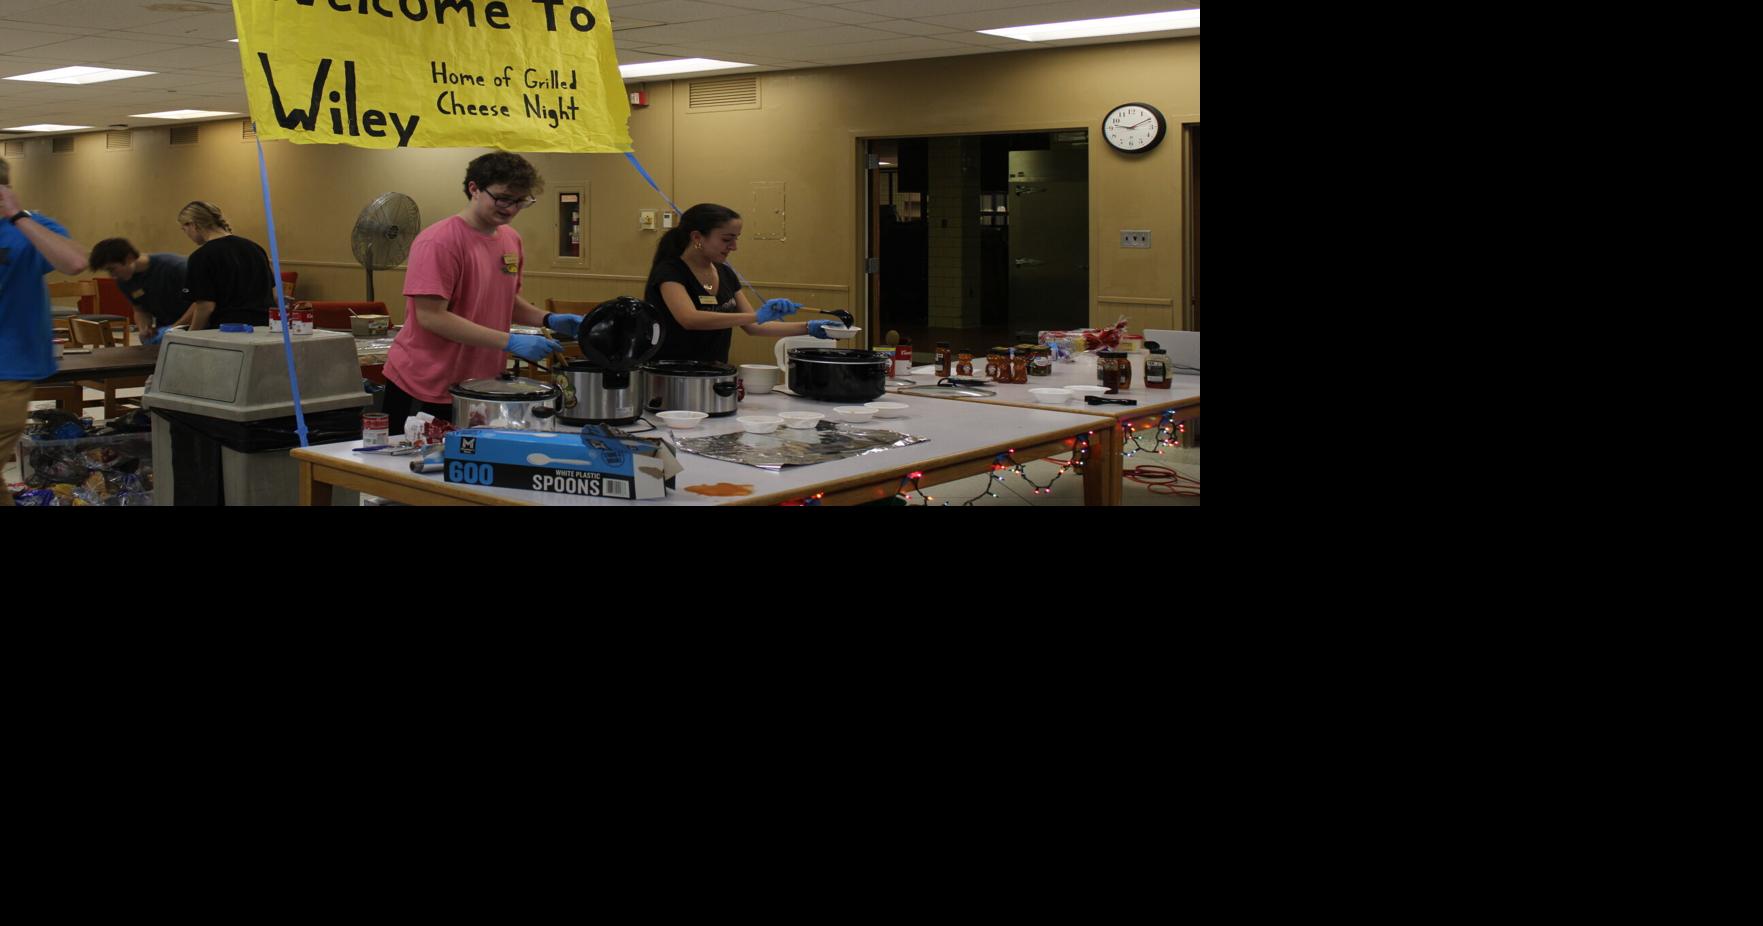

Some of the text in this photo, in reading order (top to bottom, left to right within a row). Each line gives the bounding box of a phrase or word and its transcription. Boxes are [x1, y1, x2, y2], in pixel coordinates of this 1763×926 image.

[272, 0, 596, 32] come To
[431, 61, 577, 90] Home of Grilled
[257, 52, 420, 148] Wiley
[437, 91, 579, 128] Cheese Night
[449, 461, 494, 486] 600
[532, 474, 600, 496] SPOONS
[555, 469, 600, 480] WHITE PLASTIC
